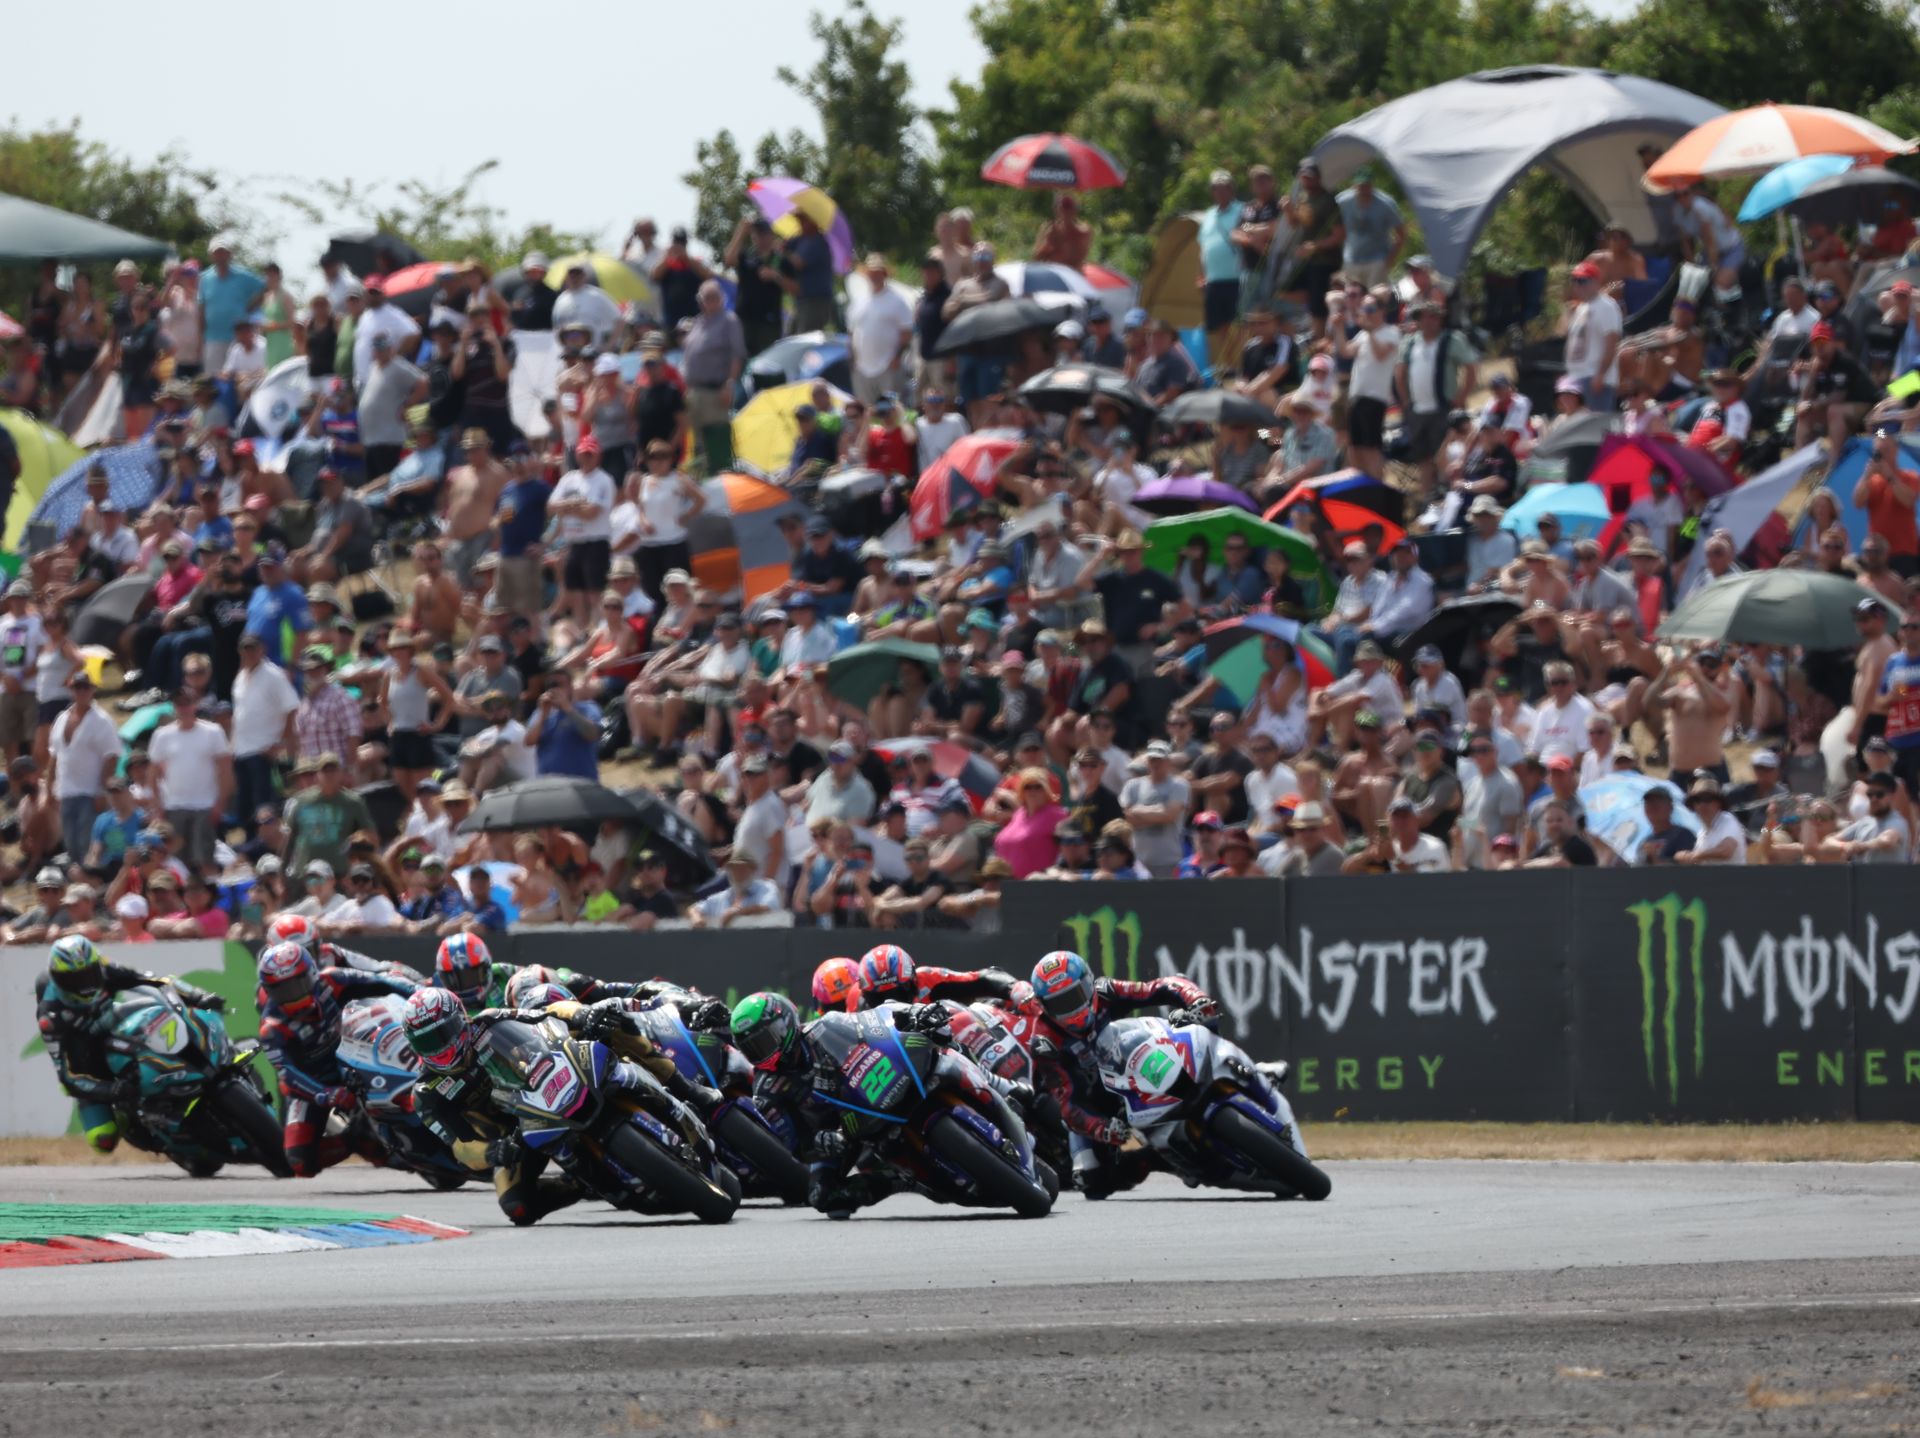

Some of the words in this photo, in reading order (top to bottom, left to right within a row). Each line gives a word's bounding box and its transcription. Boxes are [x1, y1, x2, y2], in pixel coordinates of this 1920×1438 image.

[160, 1019, 177, 1051] 7
[849, 1050, 883, 1088] McAMS
[860, 1056, 896, 1104] 22
[1298, 1055, 1443, 1093] ERGY
